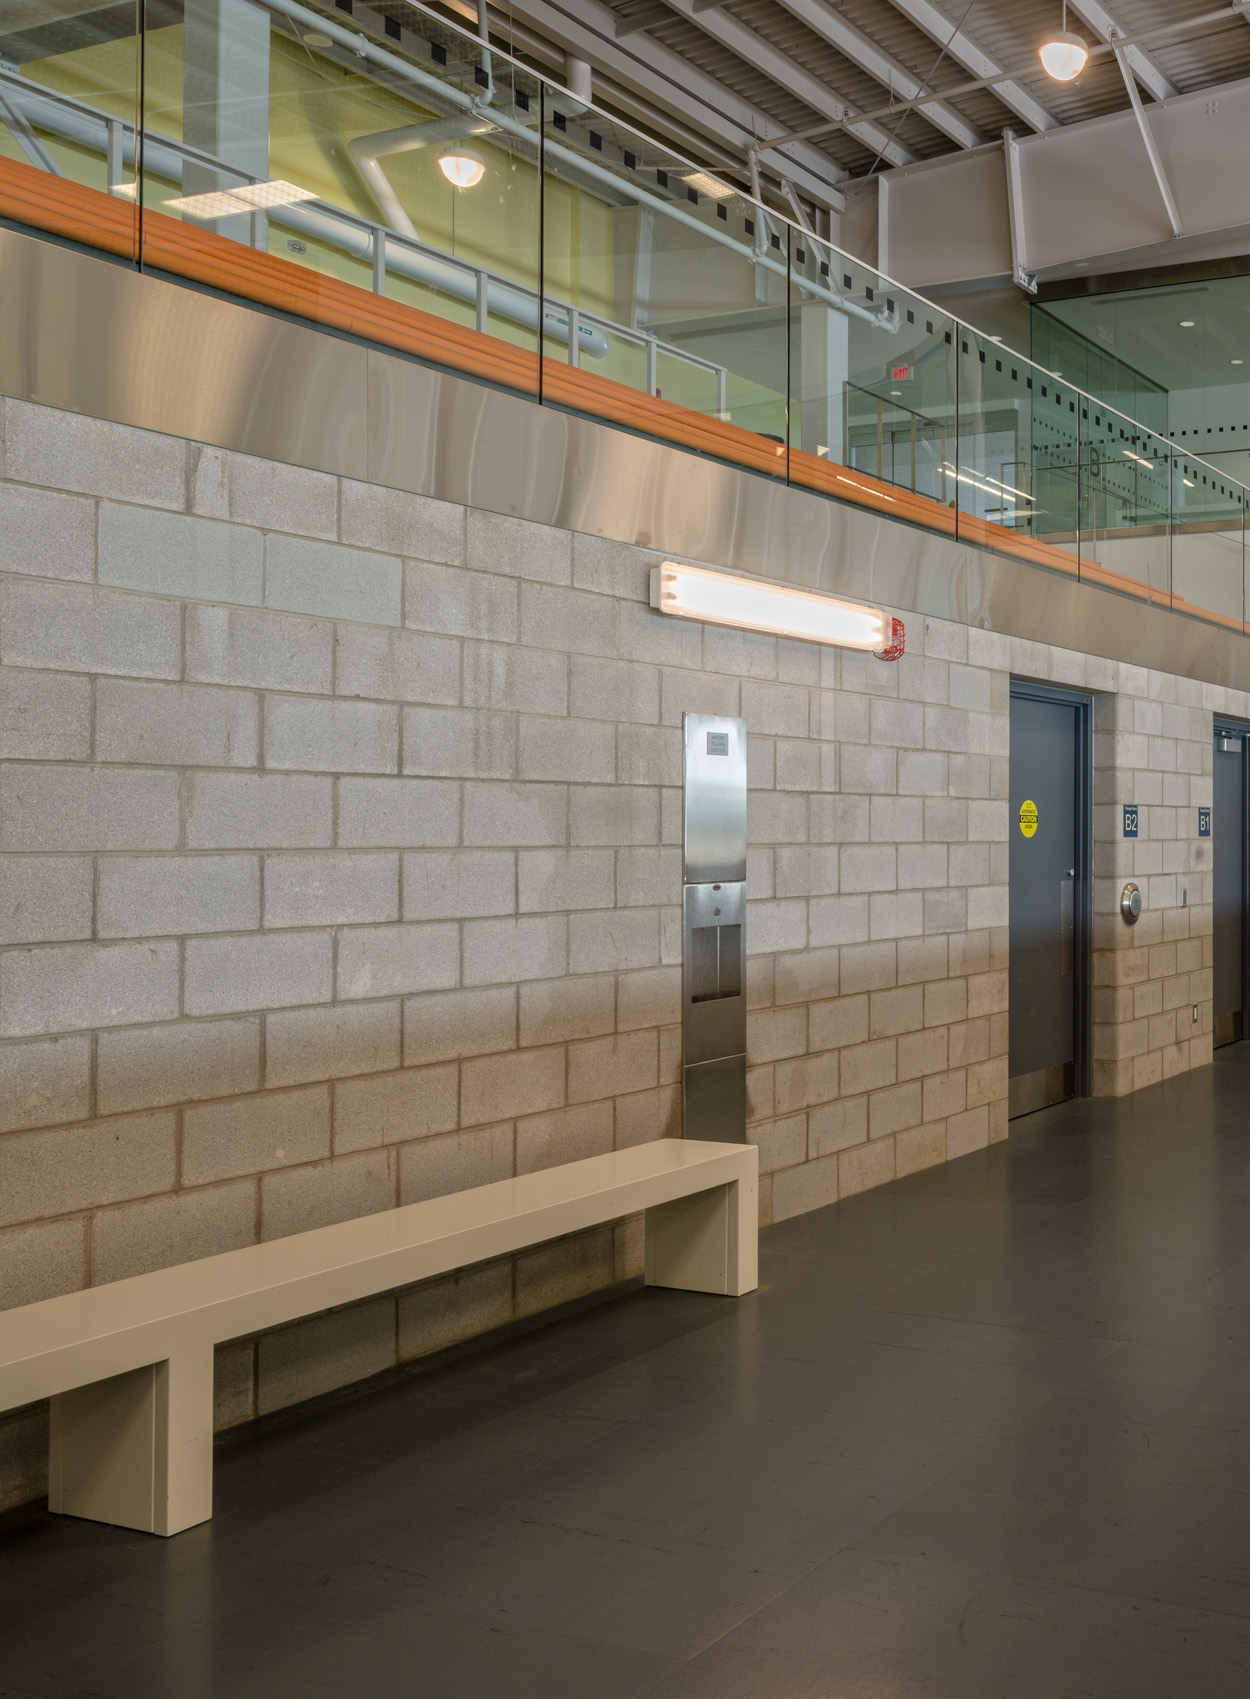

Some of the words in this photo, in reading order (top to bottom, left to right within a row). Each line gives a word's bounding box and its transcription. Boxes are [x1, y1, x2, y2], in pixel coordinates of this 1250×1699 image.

[894, 367, 908, 380] EXIT
[1020, 815, 1038, 823] CAUTION
[1125, 814, 1137, 831] B2
[1200, 815, 1210, 831] B1
